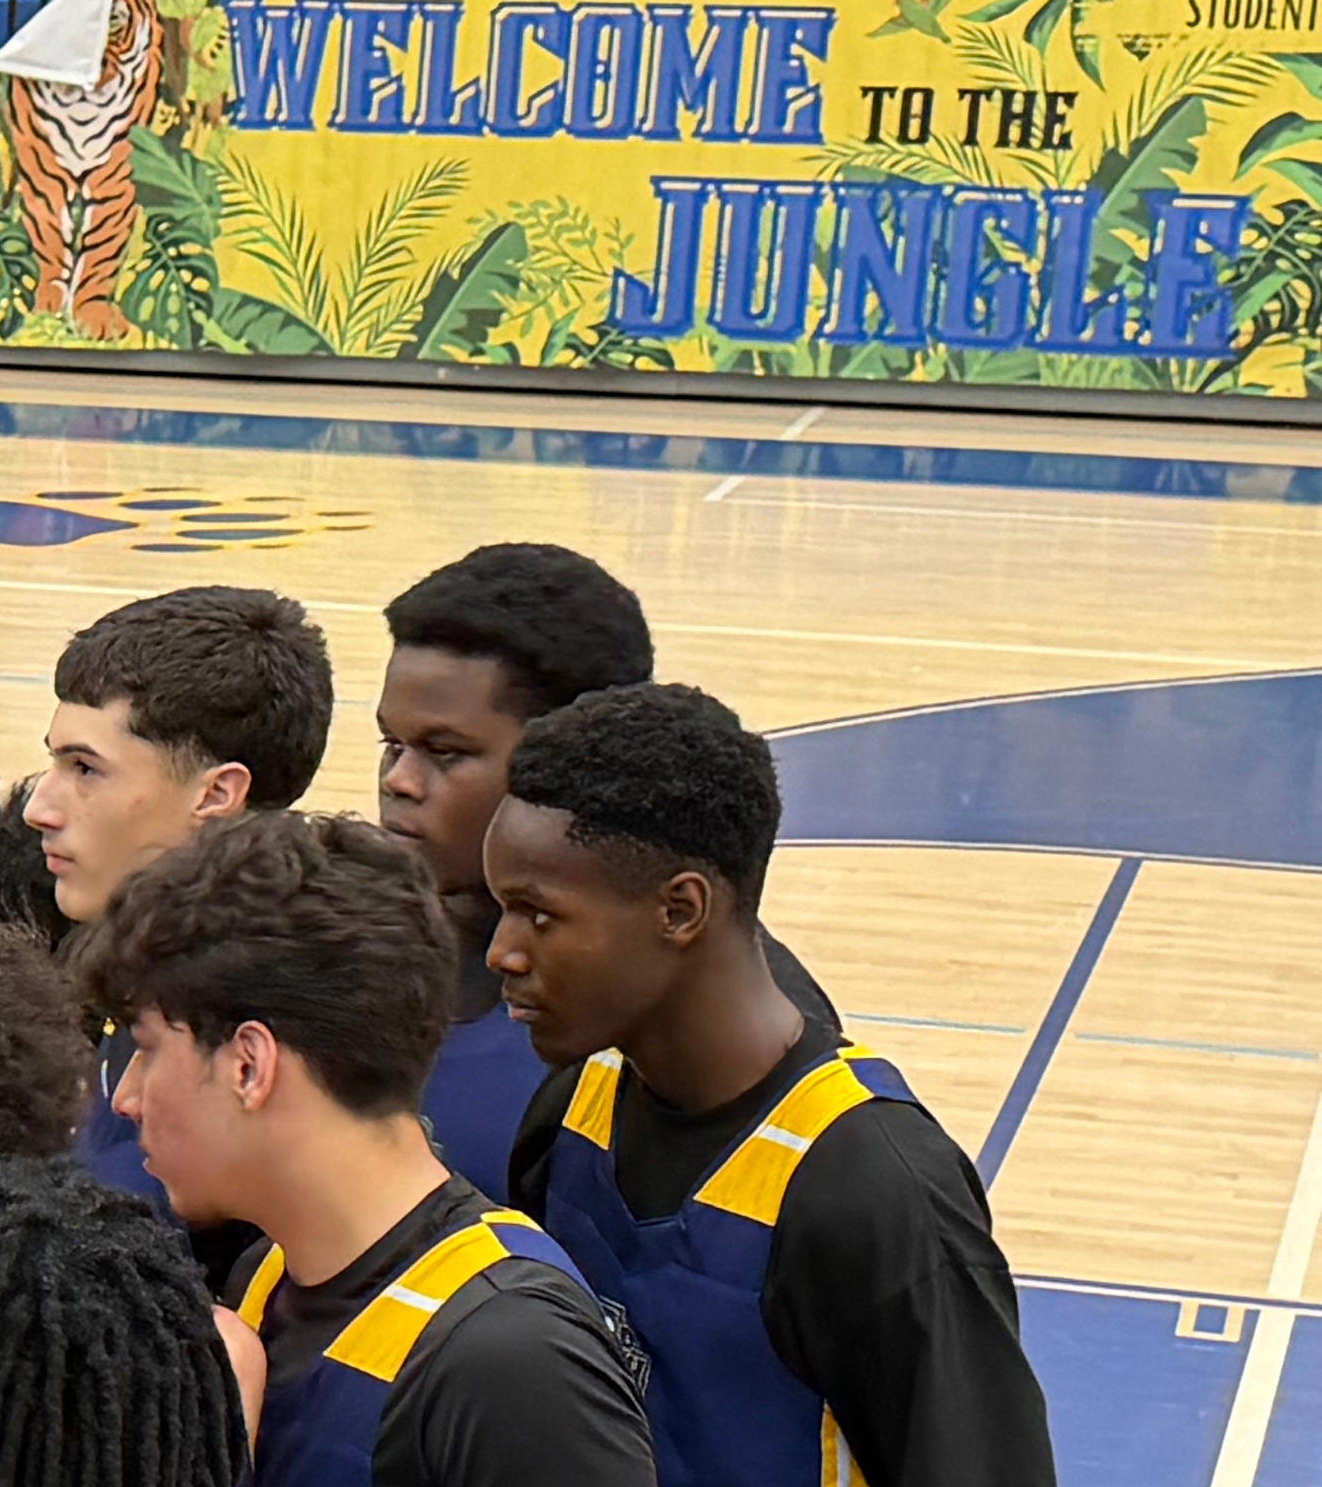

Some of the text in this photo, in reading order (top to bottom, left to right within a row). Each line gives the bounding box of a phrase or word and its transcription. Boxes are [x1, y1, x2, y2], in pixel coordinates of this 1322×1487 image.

[229, 0, 835, 144] WELCOME
[860, 86, 1079, 150] TO THE
[611, 175, 1251, 358] JUNGLE
